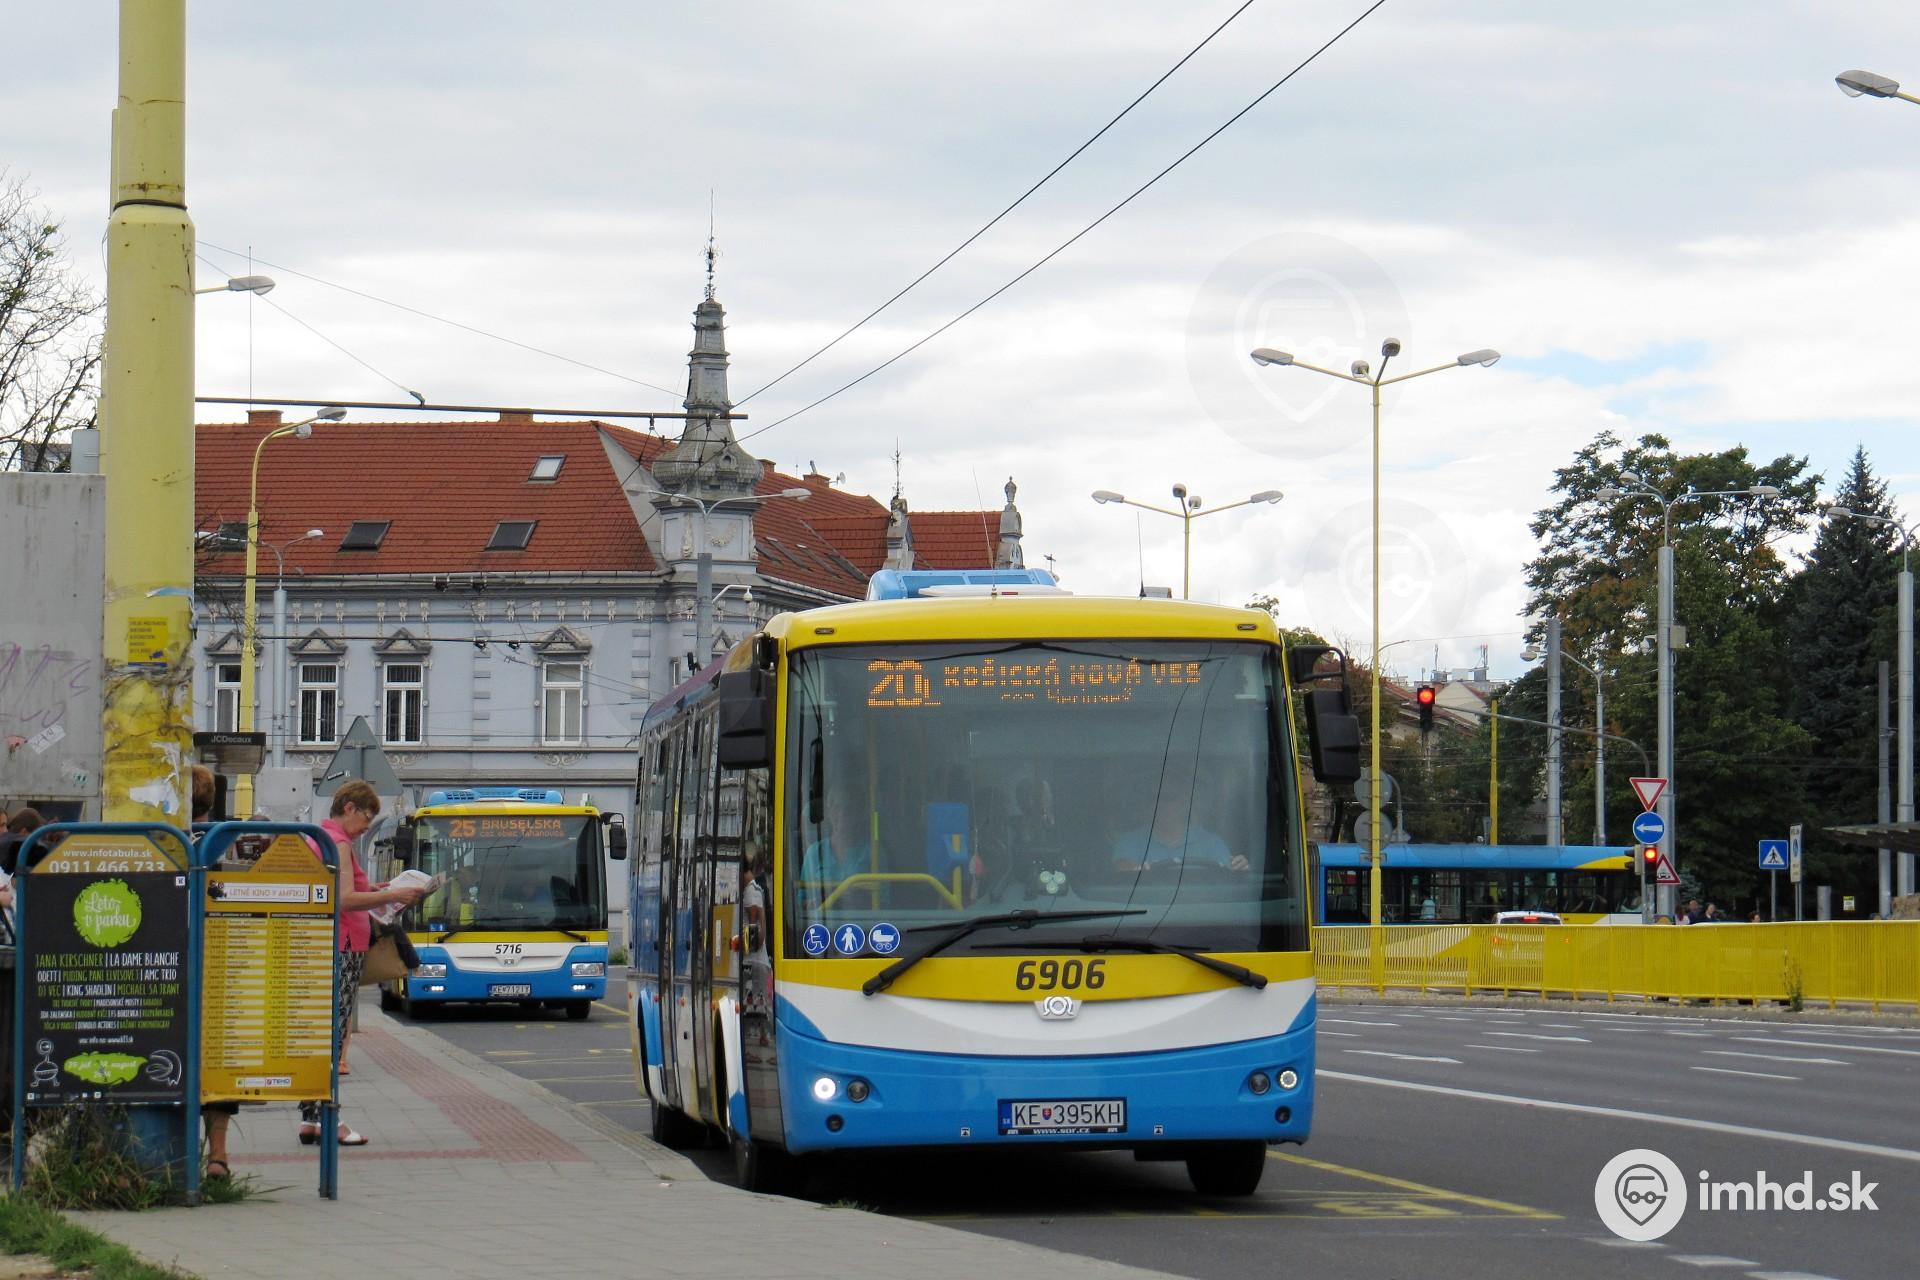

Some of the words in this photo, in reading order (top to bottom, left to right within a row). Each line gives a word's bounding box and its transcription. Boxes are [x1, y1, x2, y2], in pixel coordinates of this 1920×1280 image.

[211, 735, 251, 743] JCDecaux
[449, 819, 476, 838] 25
[63, 848, 152, 857] www.infotabula.sk
[49, 860, 90, 872] 0911
[96, 860, 129, 872] 466
[134, 861, 165, 872] 733
[229, 888, 250, 896] LETNÉ
[252, 889, 269, 897] KINO
[86, 892, 121, 913] Leto
[94, 913, 136, 934] parku
[495, 944, 522, 954] 5716
[35, 953, 57, 967] JANA
[60, 953, 104, 967] KIRSCHNER
[110, 952, 120, 967] LA
[122, 952, 143, 966] DAME
[145, 952, 180, 966] BLANCHE
[37, 970, 58, 982] ODETT
[144, 969, 159, 980] AMC
[161, 969, 177, 980] TRIO
[1016, 959, 1106, 990] 6906
[66, 985, 84, 996] KING
[117, 984, 146, 995] MICHAEL
[1015, 1105, 1040, 1125] KE
[1053, 1103, 1121, 1124] 395KH
